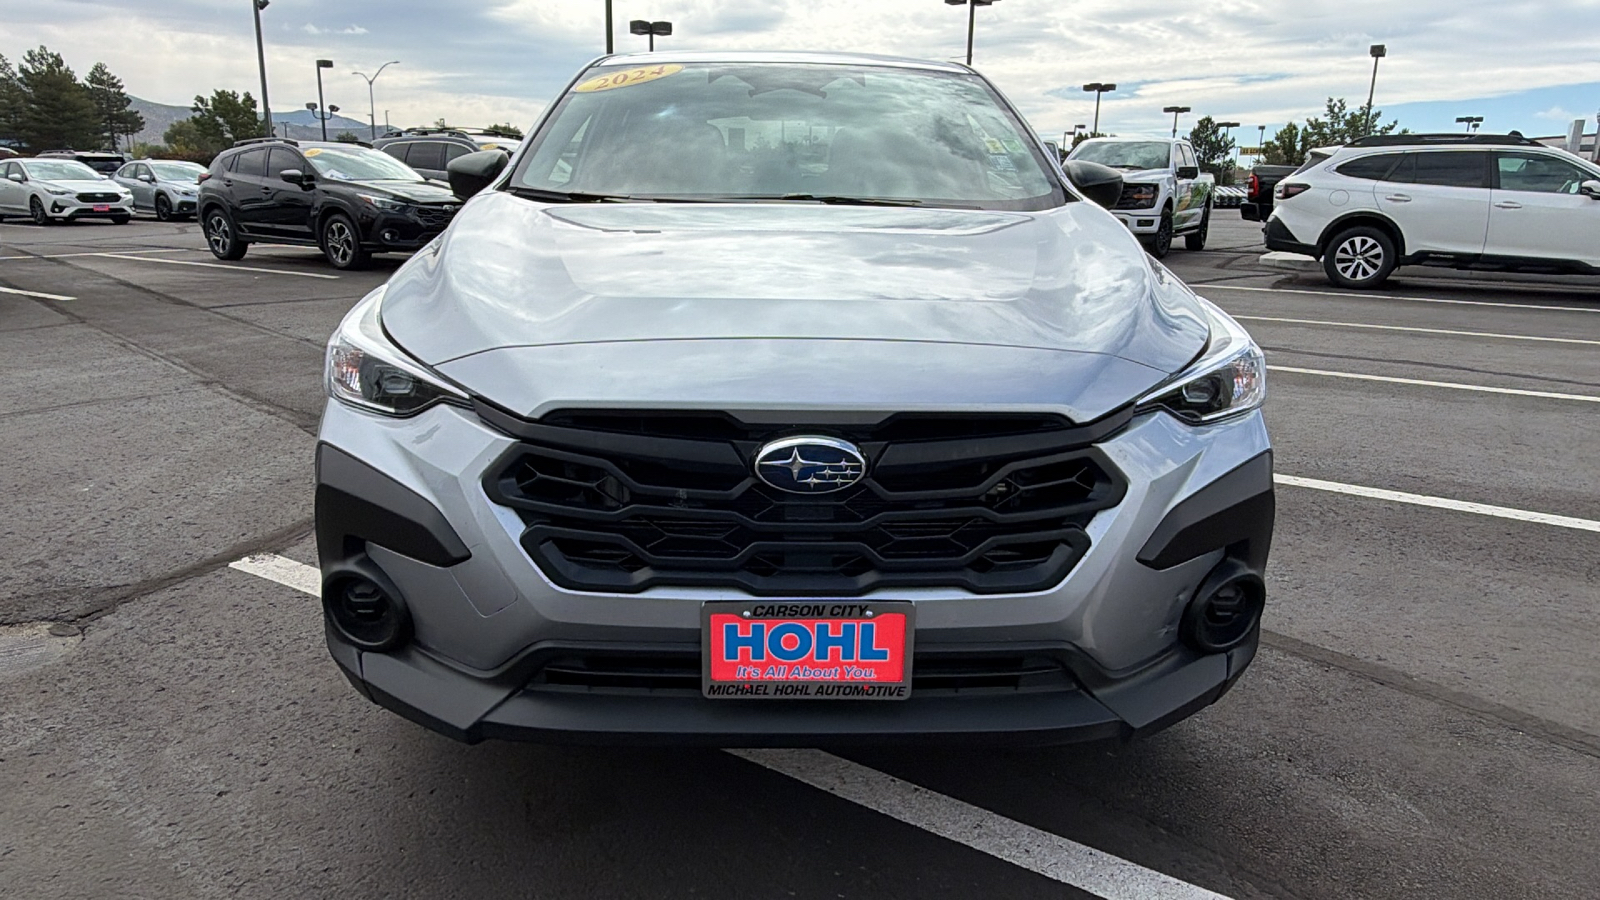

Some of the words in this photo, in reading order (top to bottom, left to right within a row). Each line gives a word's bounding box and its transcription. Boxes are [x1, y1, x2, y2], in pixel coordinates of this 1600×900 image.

[594, 65, 665, 90] 2024
[752, 605, 823, 617] CARSON
[829, 605, 868, 617] CITY
[723, 622, 890, 661] HOHL
[736, 665, 760, 678] It's
[764, 665, 786, 678] All
[790, 665, 840, 678] About
[844, 665, 877, 678] You.
[707, 684, 769, 696] MICHAEL
[773, 684, 811, 696] HOHL
[815, 685, 907, 697] AUTOMOTIVE
